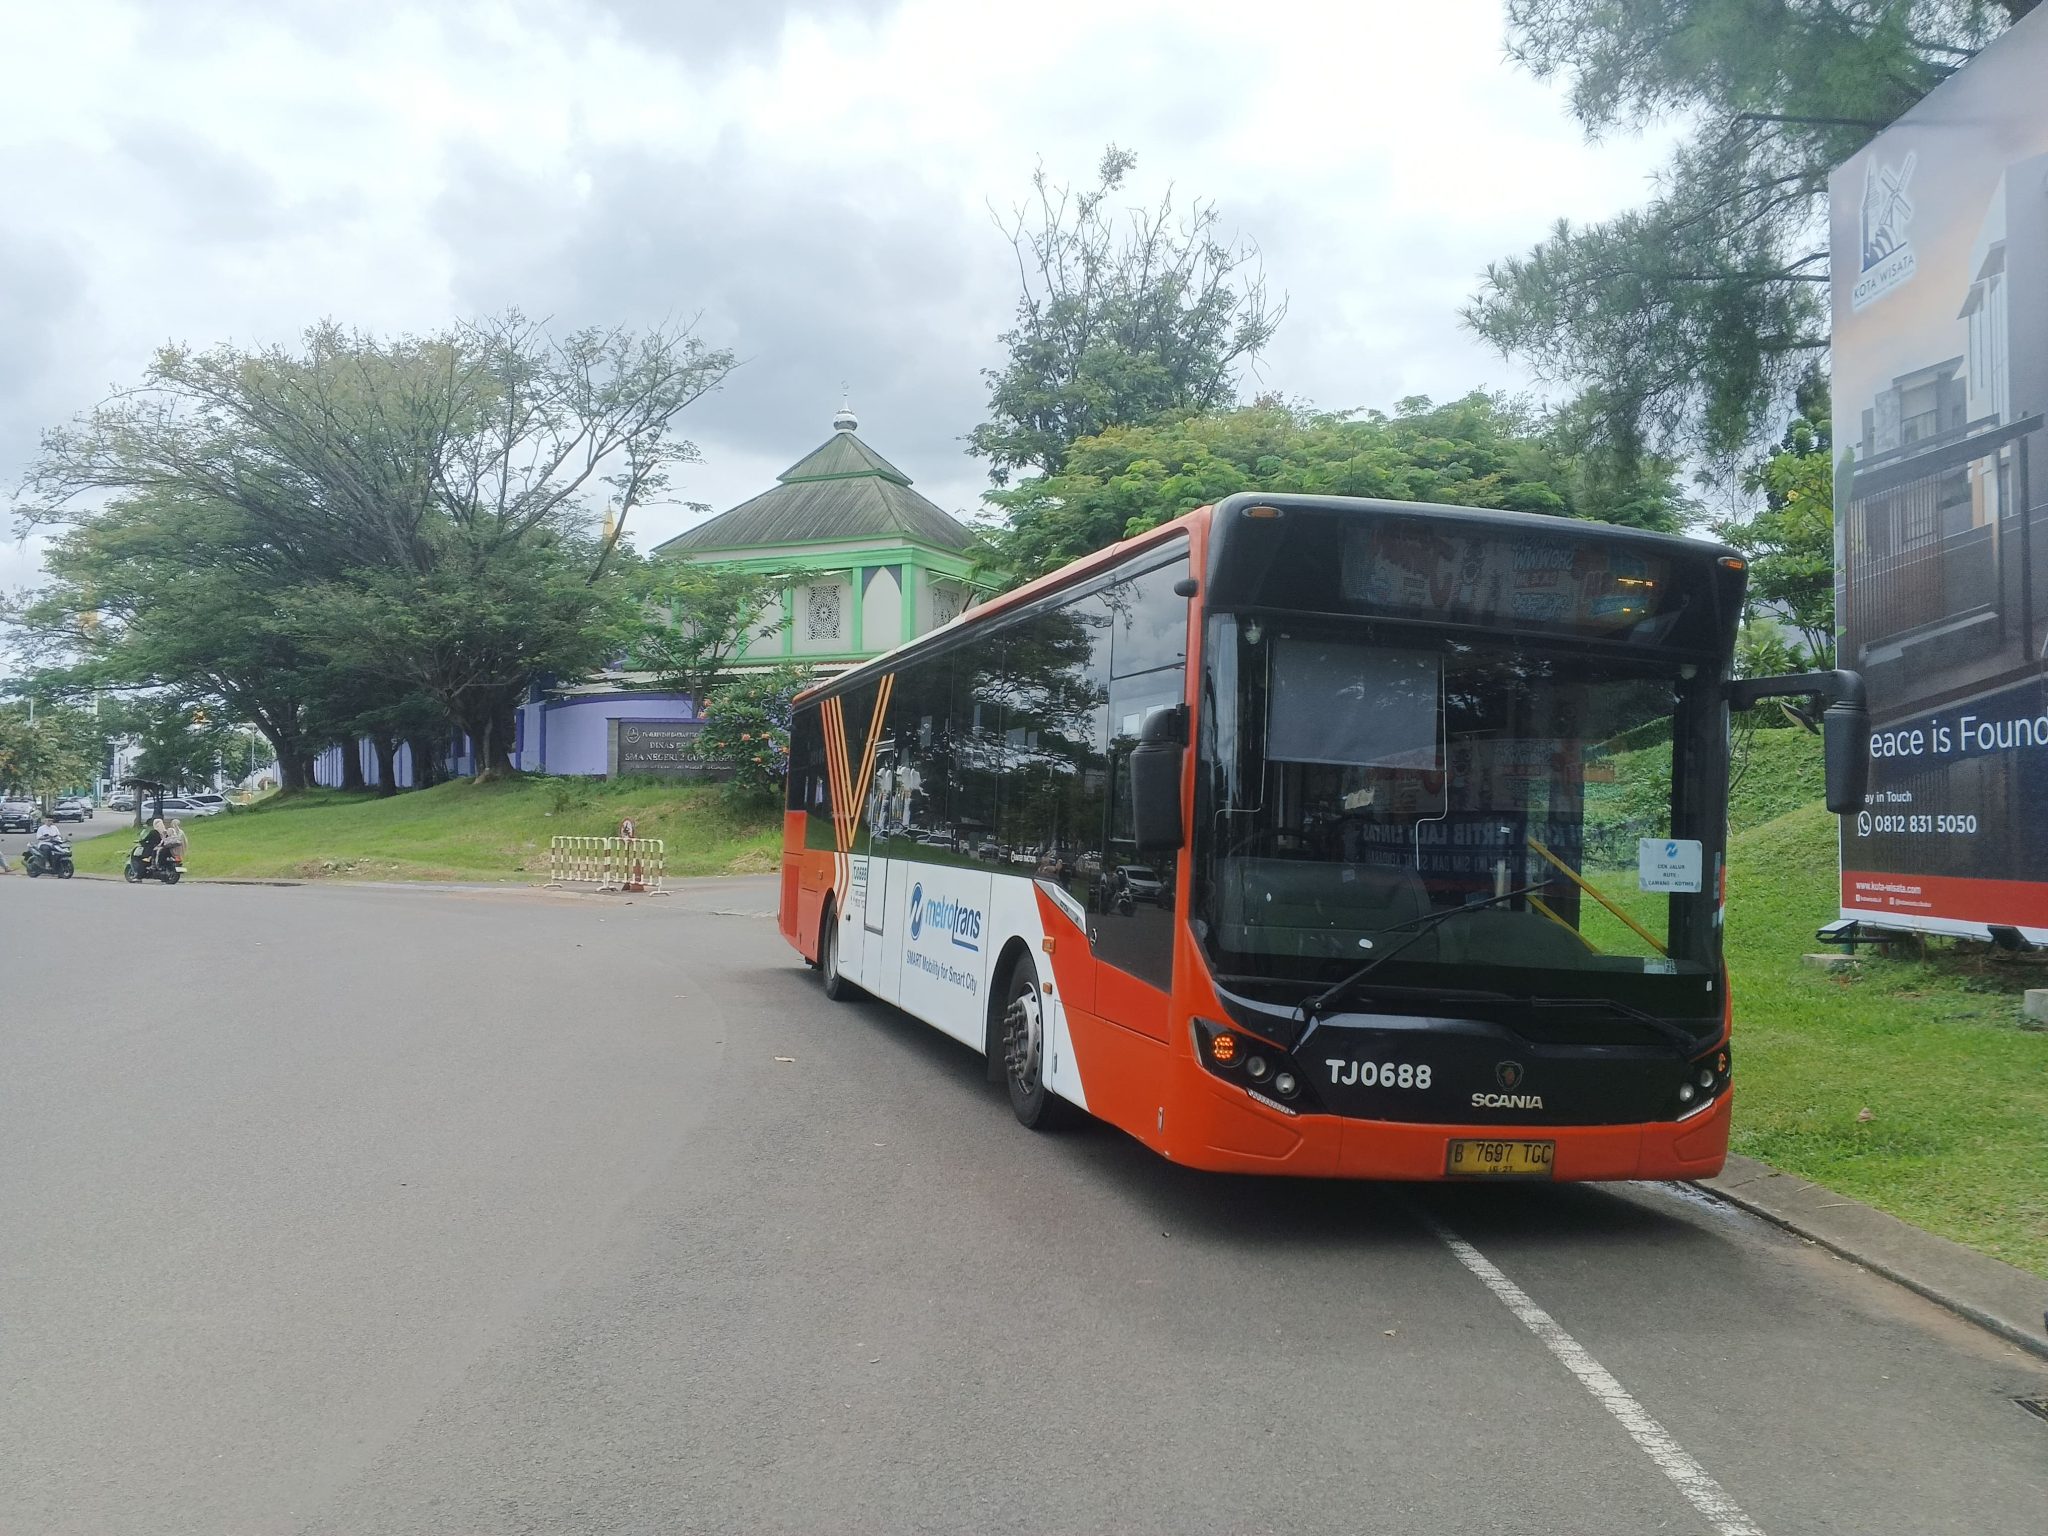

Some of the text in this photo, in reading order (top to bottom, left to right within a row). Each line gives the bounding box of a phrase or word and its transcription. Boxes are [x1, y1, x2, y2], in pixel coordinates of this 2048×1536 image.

[1854, 279, 1877, 300] KOTA
[1880, 255, 1914, 281] WISATA
[650, 741, 675, 749] DINAS
[1869, 729, 1924, 758] eace
[1932, 719, 1951, 753] is
[625, 752, 645, 761] SMA
[646, 752, 678, 761] NEGERI
[679, 753, 685, 761] 2
[1864, 790, 1913, 805] ay in Touch
[1874, 815, 1977, 833] 0812 831 5050
[925, 895, 981, 942] metrotrans
[906, 949, 978, 996] SMART Mobility for Smart City
[1325, 1058, 1432, 1090] TJ0688
[1471, 1092, 1543, 1110] SCANIA
[1454, 1146, 1463, 1163] B
[1476, 1144, 1514, 1163] 7697
